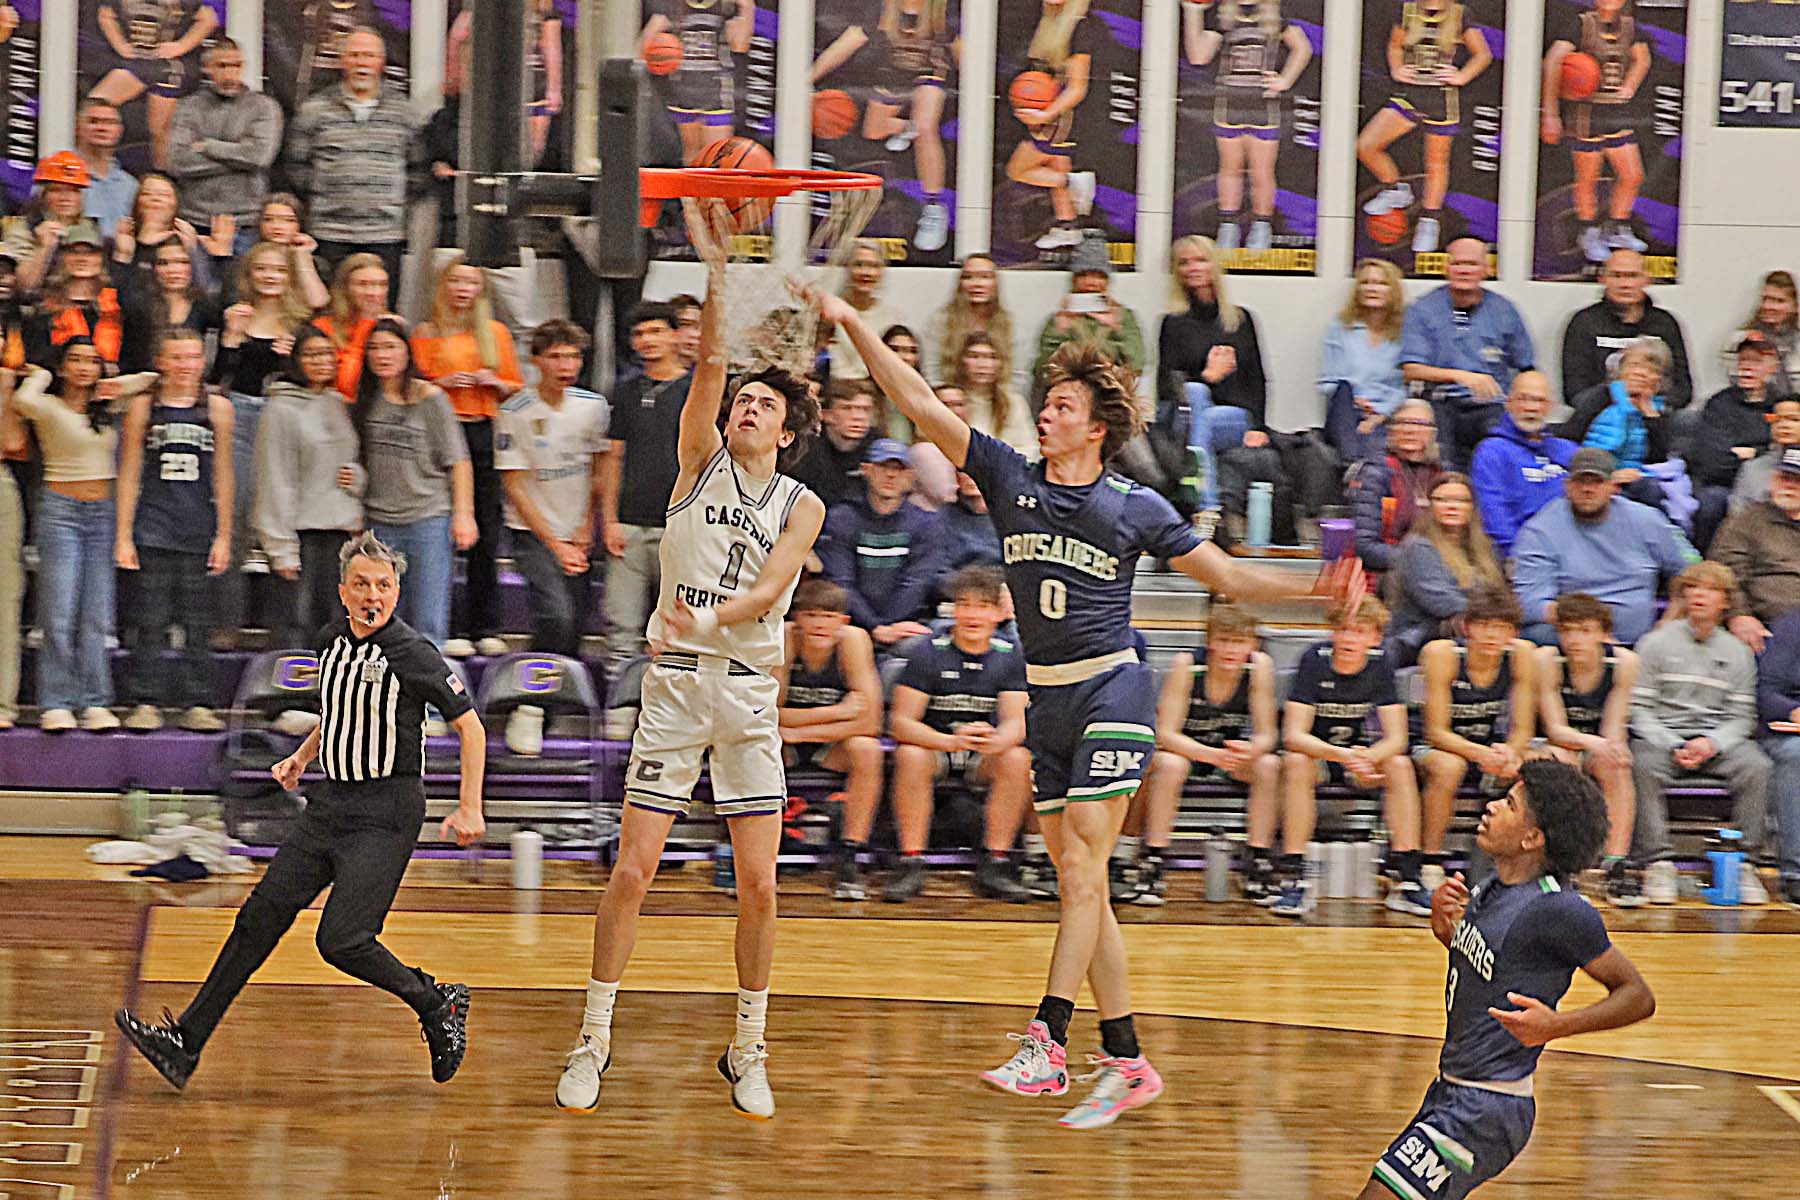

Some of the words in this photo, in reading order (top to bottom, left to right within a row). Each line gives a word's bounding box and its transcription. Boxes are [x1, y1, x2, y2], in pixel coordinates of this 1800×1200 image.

[745, 36, 775, 131] FORWARD
[1109, 71, 1137, 123] POST
[1292, 95, 1321, 147] POST
[1653, 85, 1682, 136] WING
[1471, 105, 1500, 171] GUARD
[719, 541, 747, 590] 1
[1003, 532, 1119, 581] CRUSADERS
[1039, 578, 1067, 620] 0
